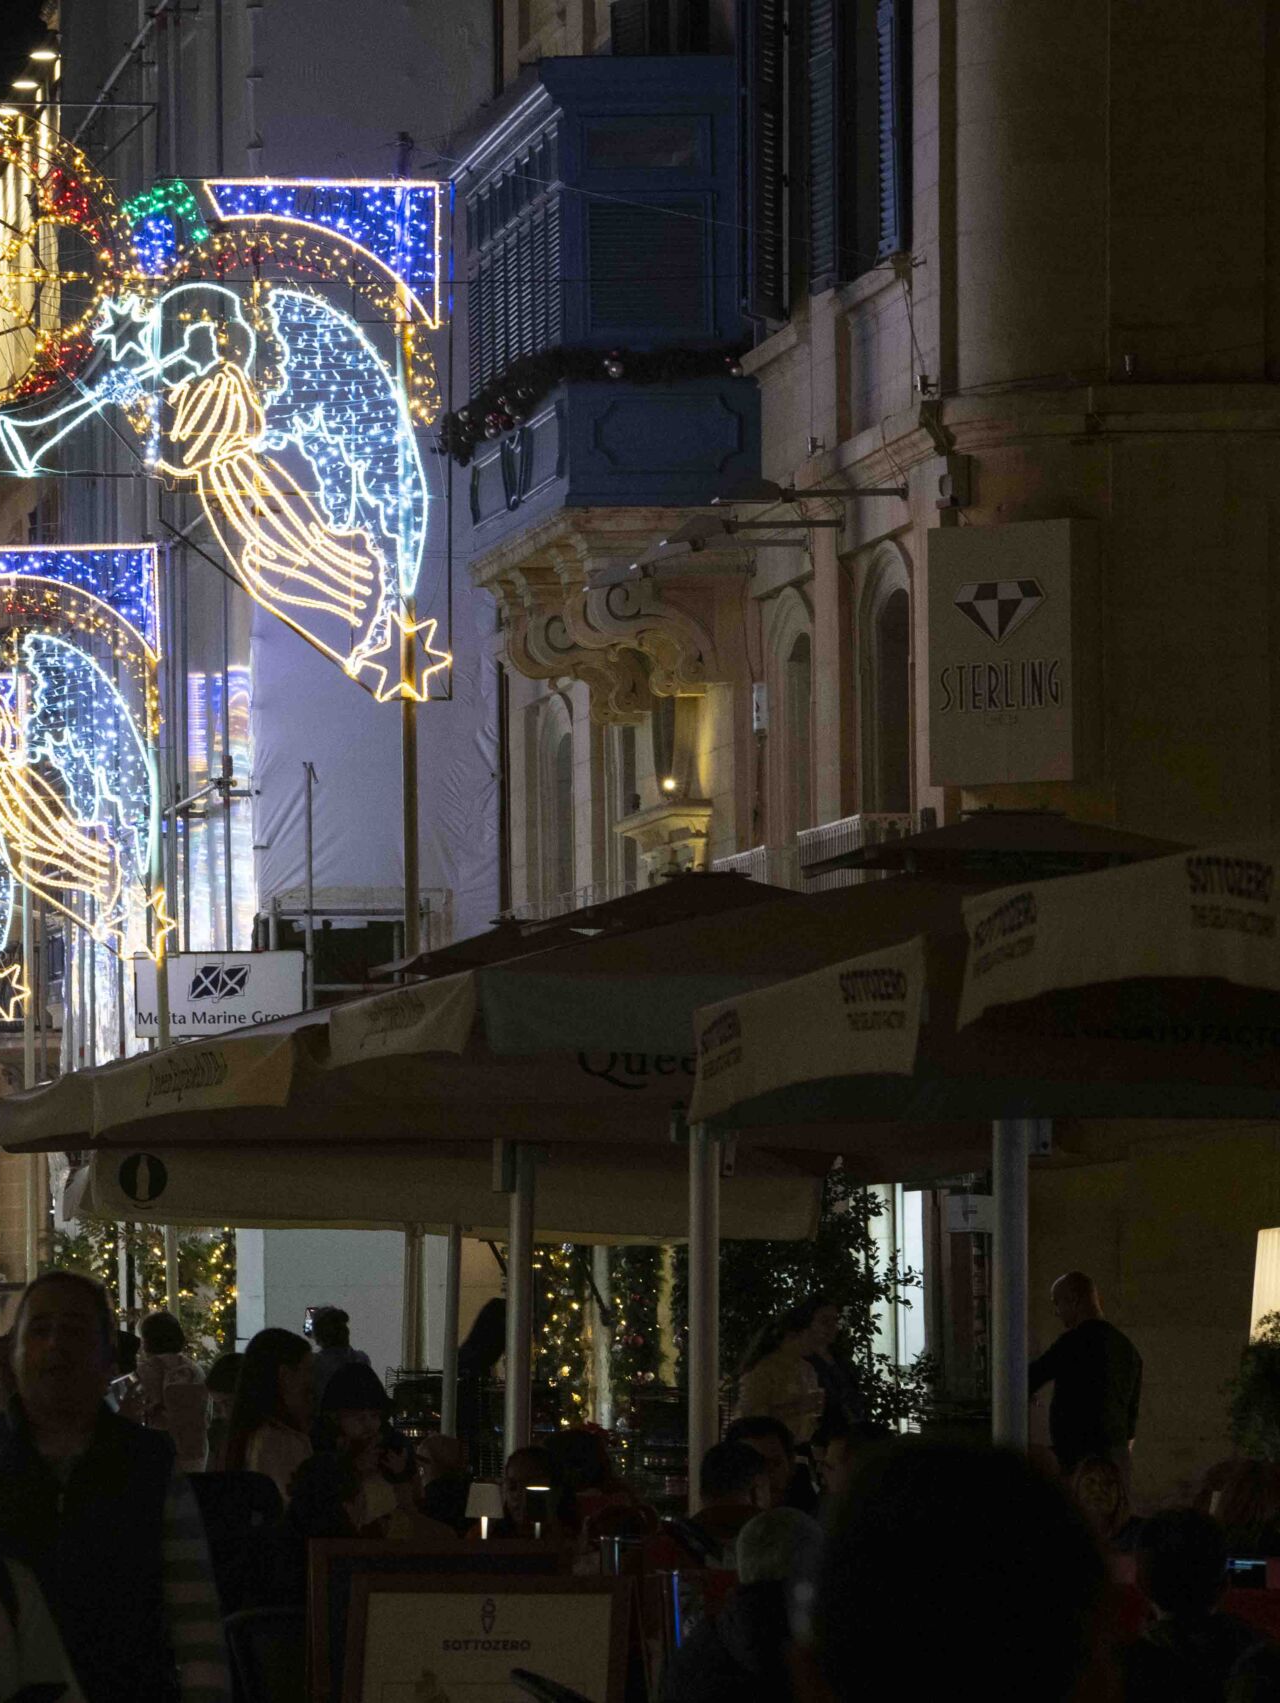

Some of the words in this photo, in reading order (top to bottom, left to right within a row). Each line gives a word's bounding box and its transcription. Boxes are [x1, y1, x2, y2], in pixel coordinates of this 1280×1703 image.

[940, 660, 1060, 711] STERLING
[138, 1011, 186, 1024] Meita
[192, 1011, 246, 1024] Marine
[442, 1640, 531, 1651] SOTTOZERO
